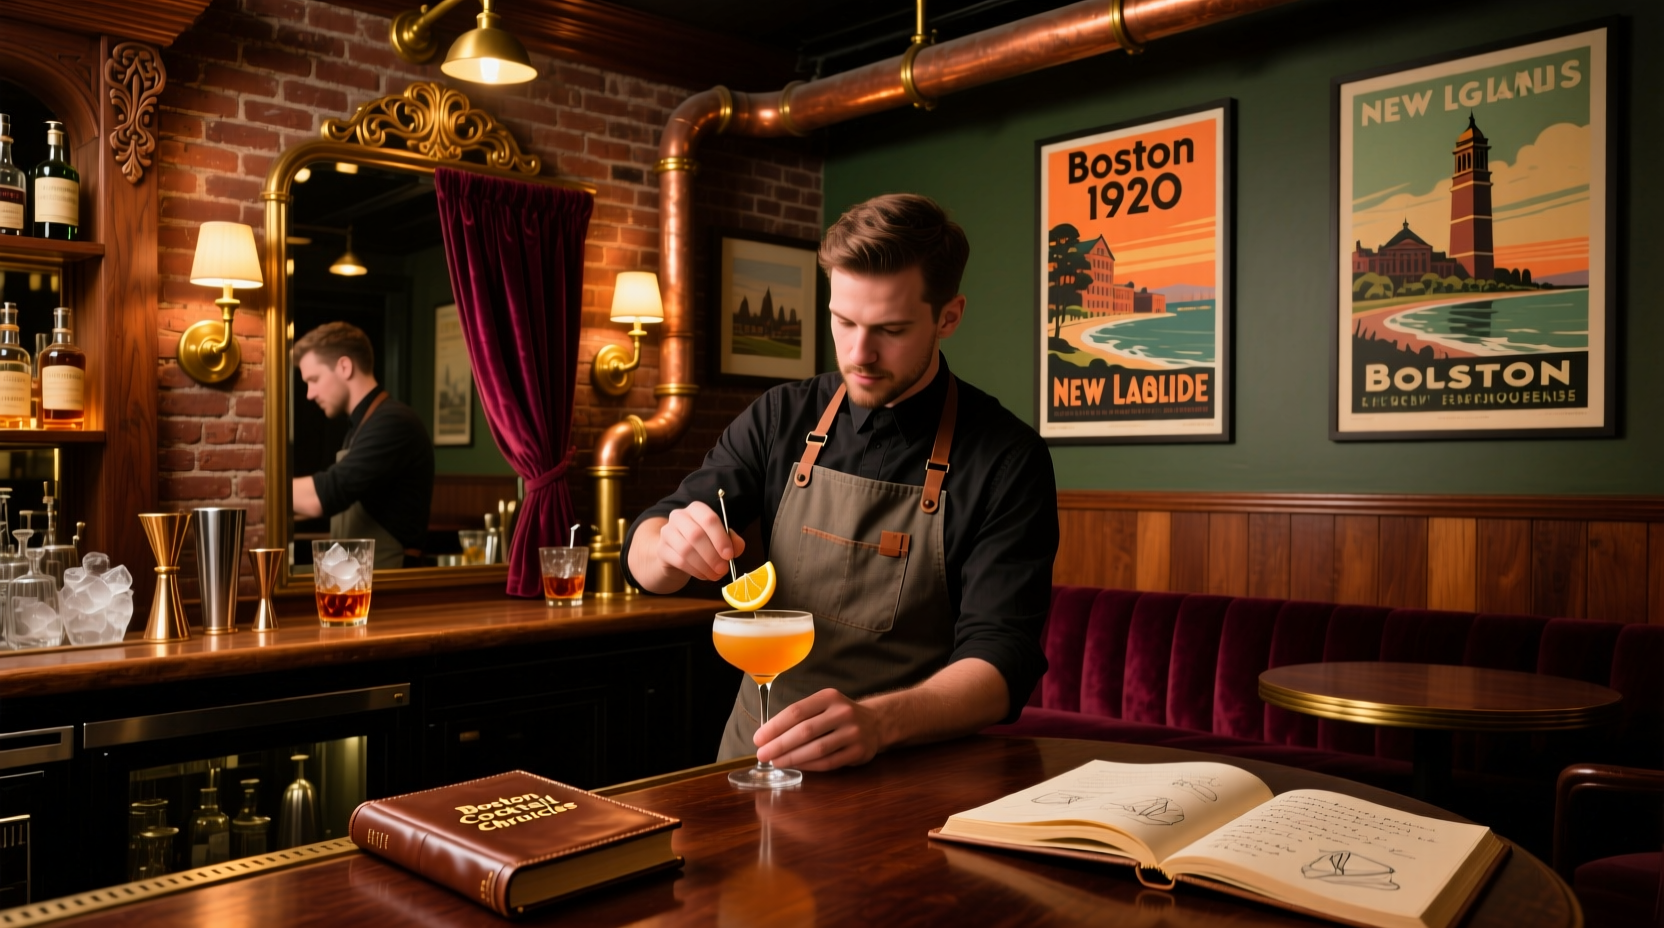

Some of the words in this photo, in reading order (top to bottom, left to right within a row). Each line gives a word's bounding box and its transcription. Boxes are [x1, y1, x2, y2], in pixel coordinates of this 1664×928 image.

[1361, 89, 1433, 127] NEW
[1068, 137, 1194, 185] Boston
[1087, 172, 1182, 220] 1920
[1053, 376, 1106, 407] NEW
[1365, 360, 1570, 392] BOLSTON
